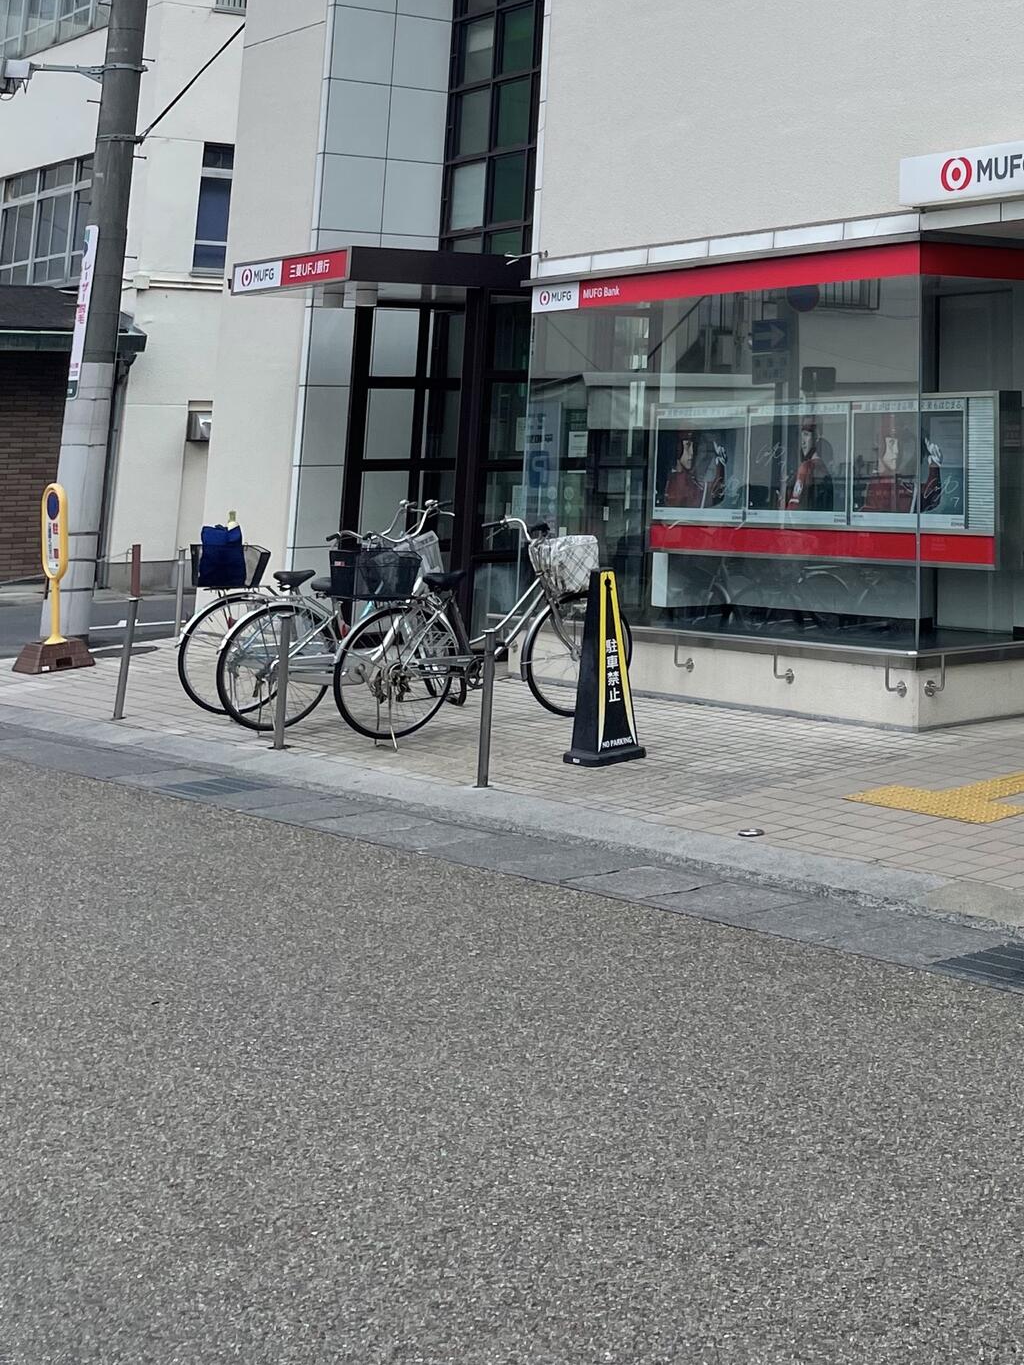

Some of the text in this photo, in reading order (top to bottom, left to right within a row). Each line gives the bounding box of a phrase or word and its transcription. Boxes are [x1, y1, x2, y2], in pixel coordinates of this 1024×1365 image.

[253, 268, 274, 283] MUFG
[289, 259, 330, 278] 三菱UFJ銀行
[551, 291, 571, 302] MUFG
[583, 285, 620, 299] MUFG Bank
[605, 638, 621, 703] 駐車禁止
[602, 736, 632, 749] NO PARKING
